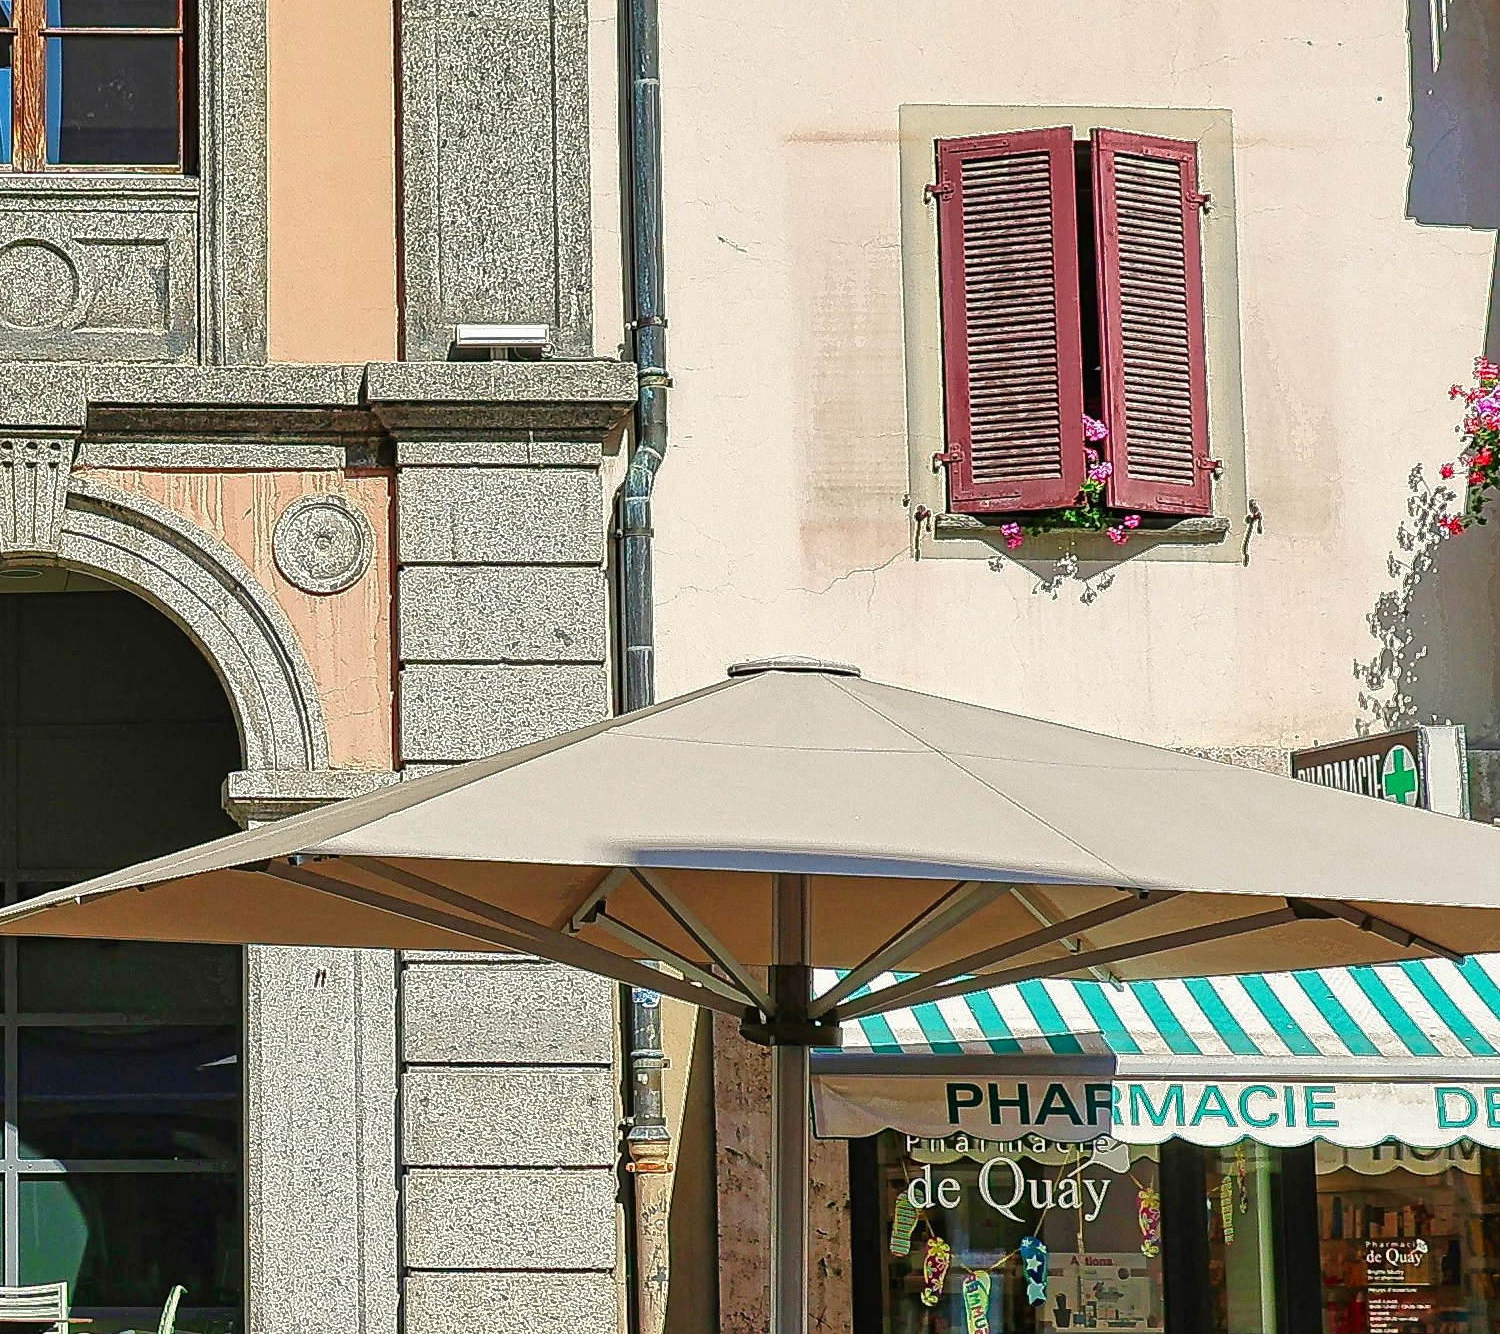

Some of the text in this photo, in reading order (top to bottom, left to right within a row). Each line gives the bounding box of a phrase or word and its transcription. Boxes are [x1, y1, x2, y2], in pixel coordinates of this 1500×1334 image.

[946, 1082, 1339, 1128] PHARMACIE
[907, 1164, 961, 1209] de
[1366, 1250, 1382, 1263] de
